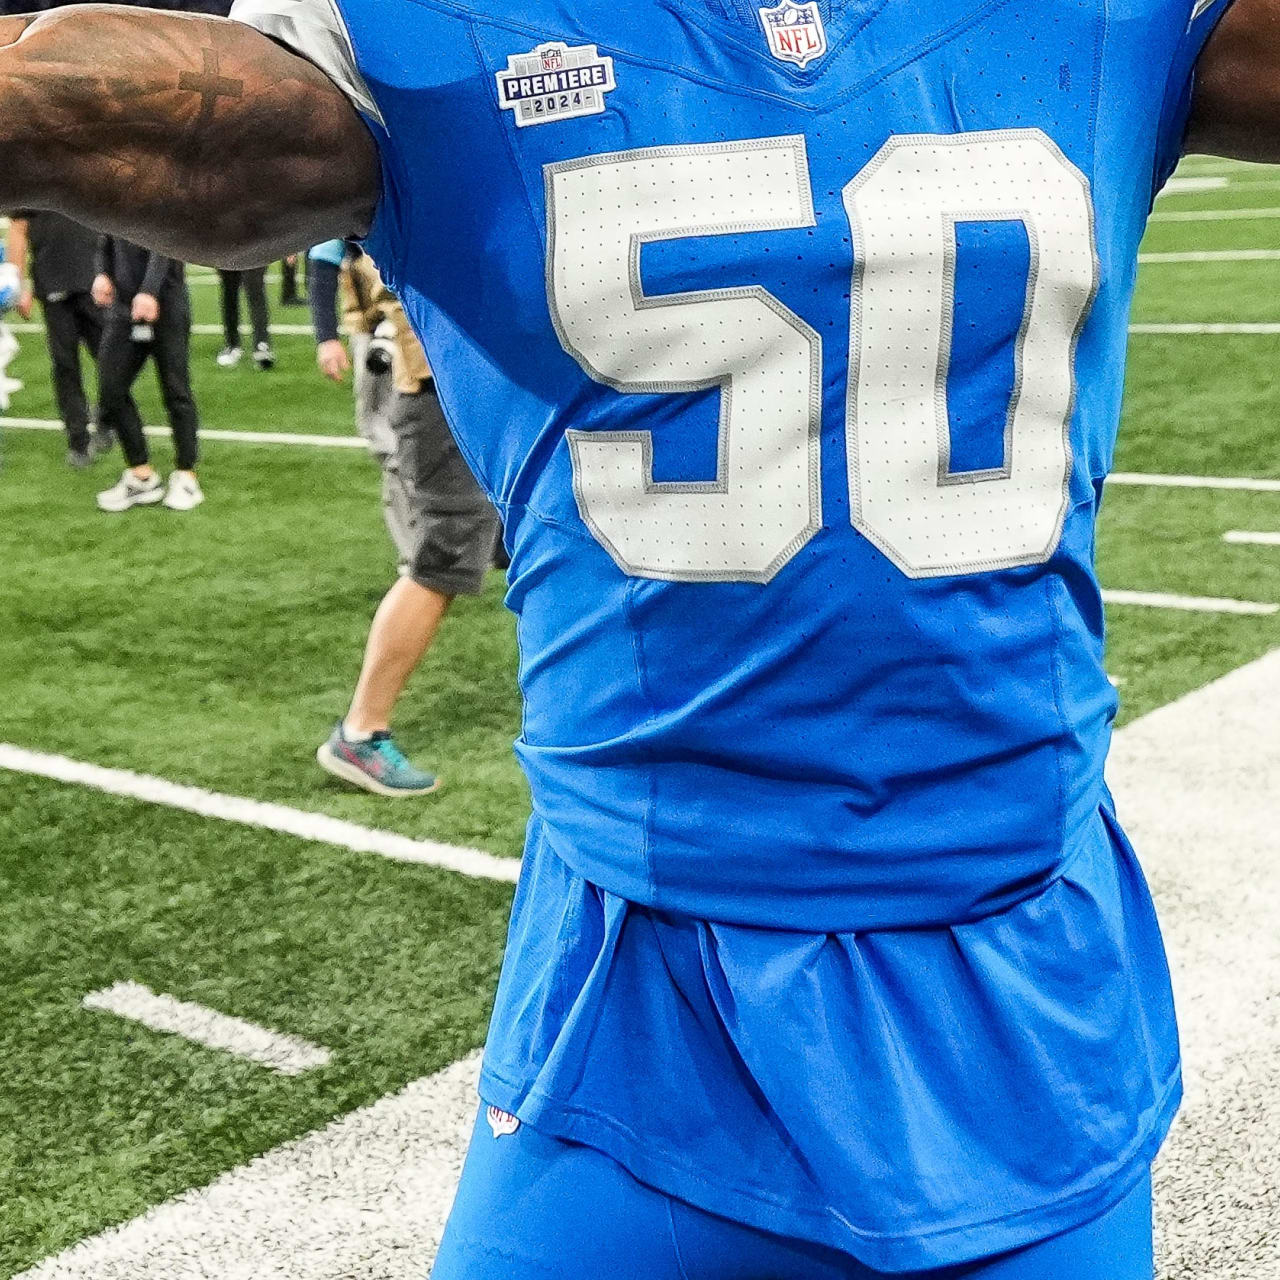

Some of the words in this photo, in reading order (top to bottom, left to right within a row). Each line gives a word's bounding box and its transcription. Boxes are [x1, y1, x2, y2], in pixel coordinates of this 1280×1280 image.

[776, 27, 817, 54] NFL
[543, 57, 561, 69] NFL
[543, 128, 1100, 584] 50
